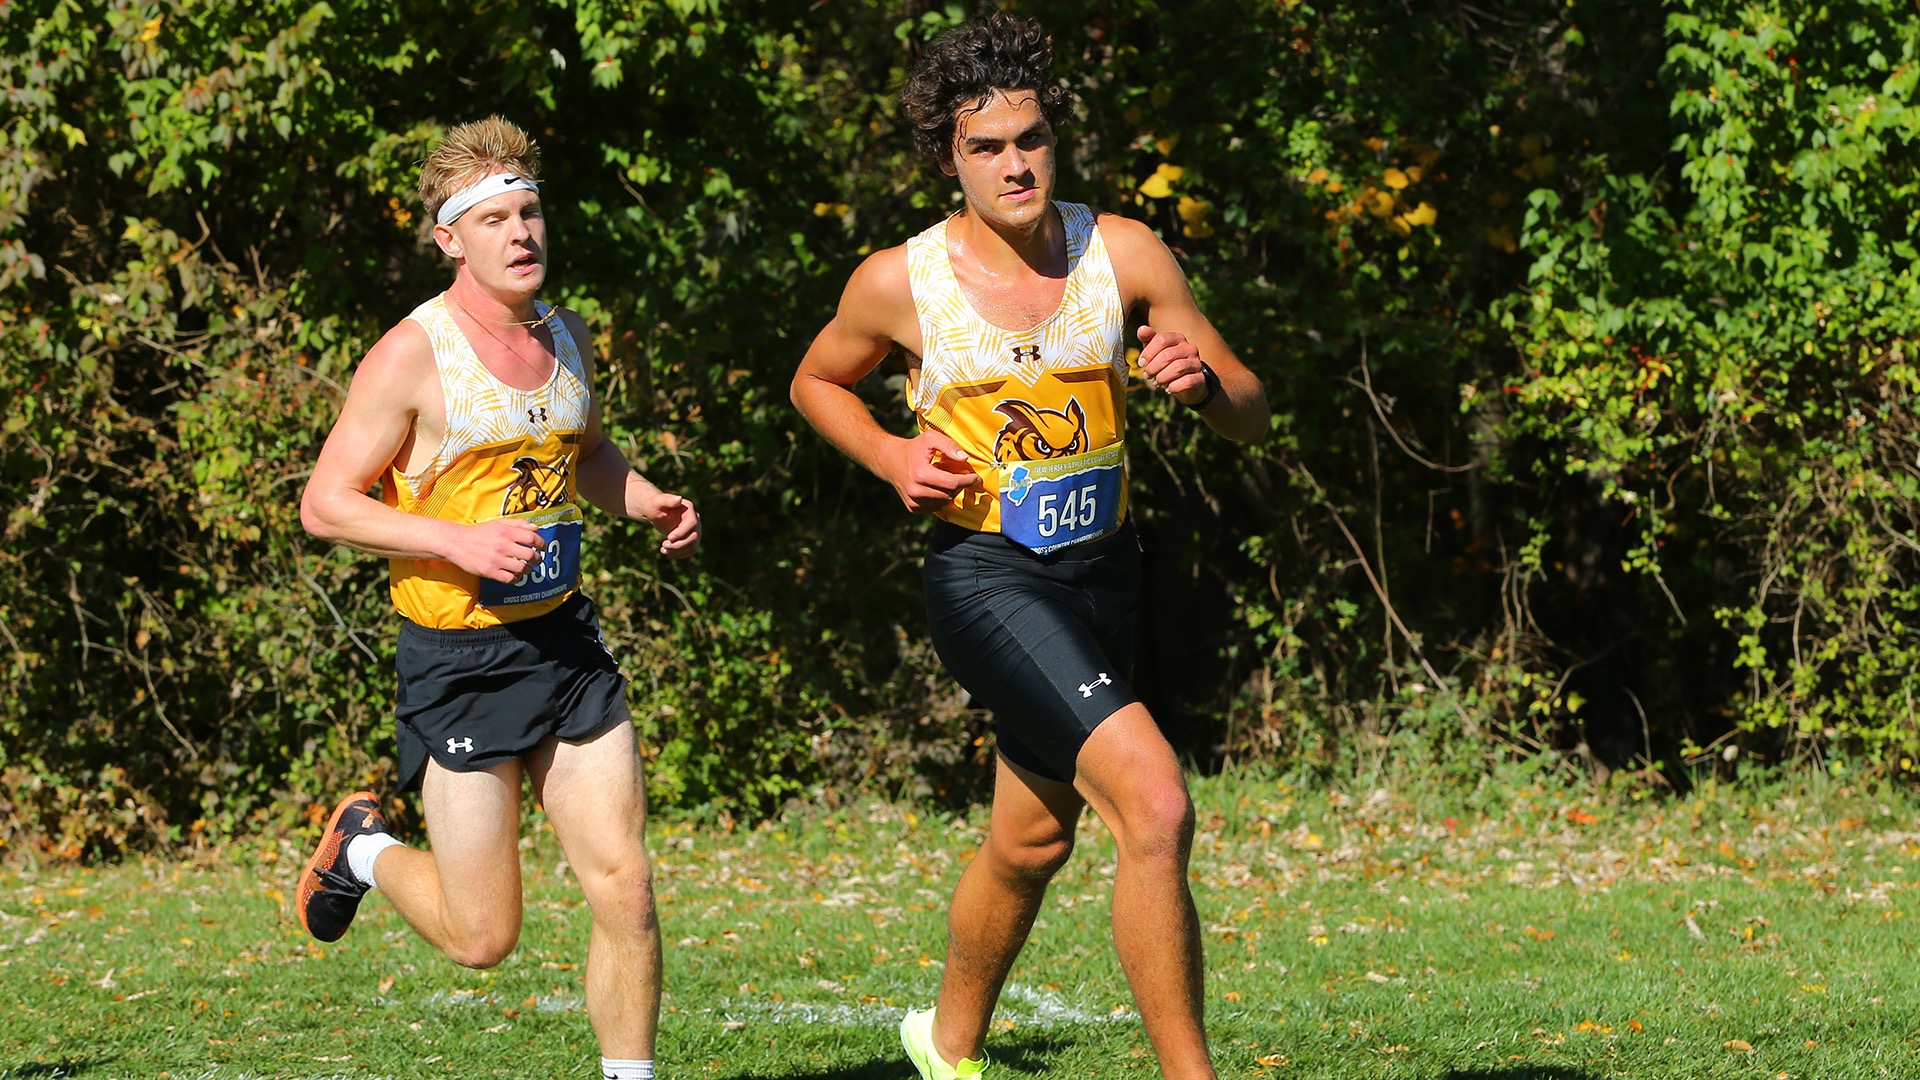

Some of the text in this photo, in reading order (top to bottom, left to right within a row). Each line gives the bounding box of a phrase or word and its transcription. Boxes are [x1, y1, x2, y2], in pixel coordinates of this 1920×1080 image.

[1034, 466, 1047, 474] NEW
[1049, 463, 1067, 473] JERSEY
[1068, 459, 1091, 469] ATHLETIC
[1038, 484, 1097, 537] 545
[504, 595, 519, 603] CROSS
[520, 593, 540, 602] COUNTRY
